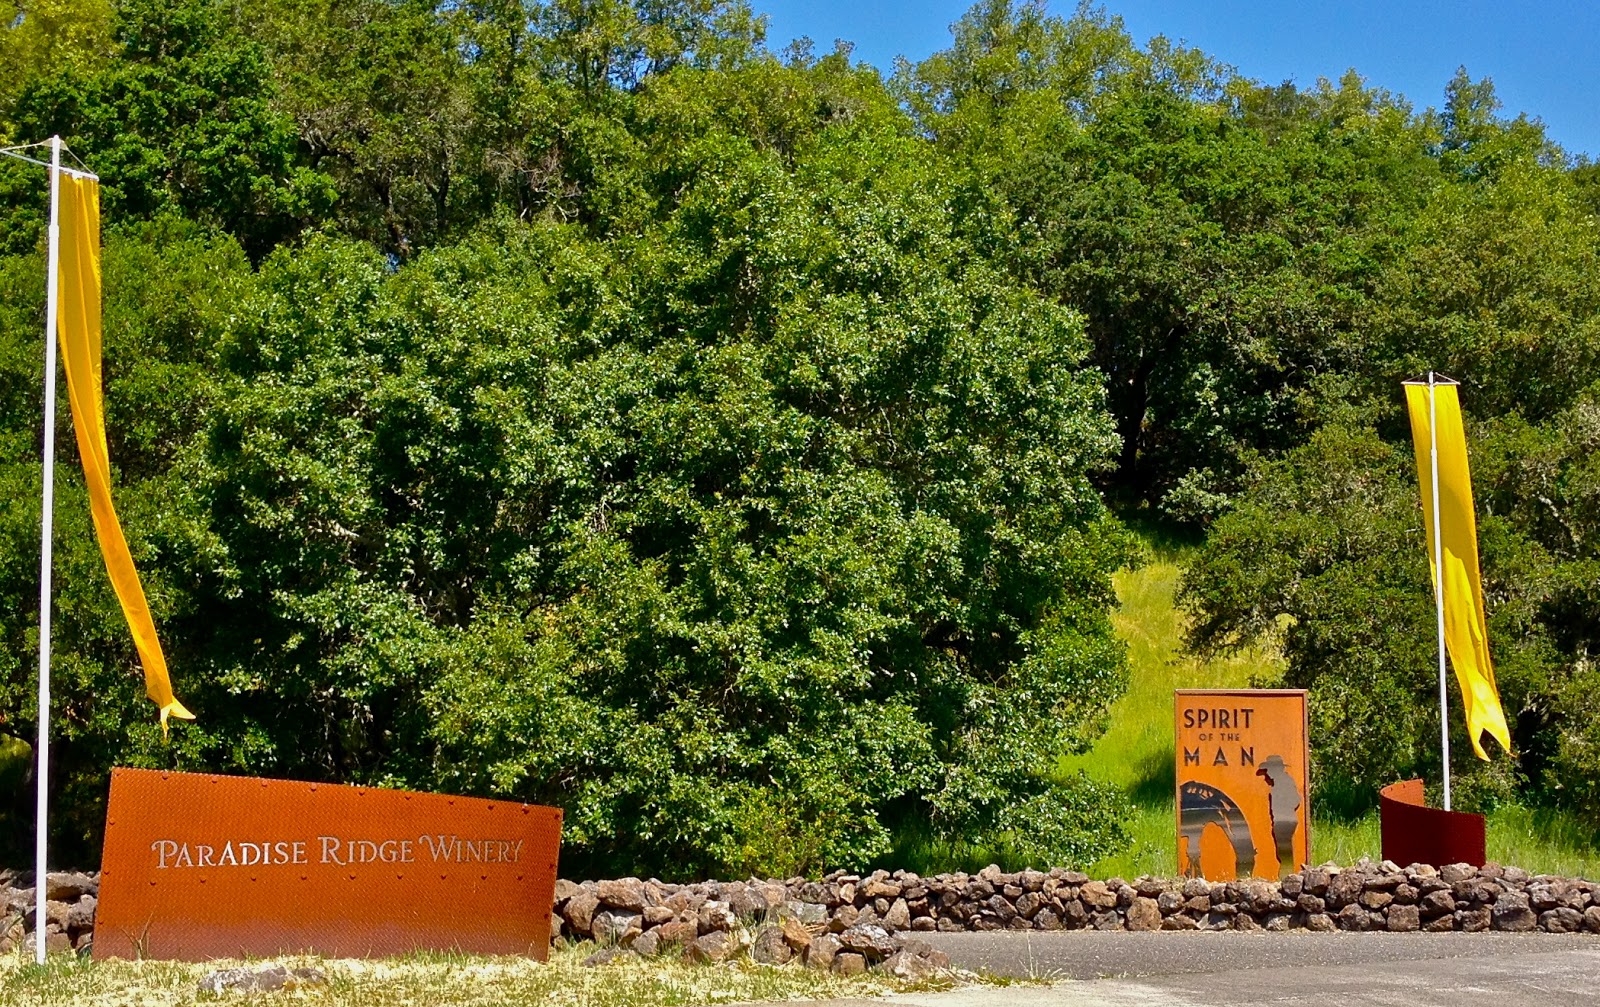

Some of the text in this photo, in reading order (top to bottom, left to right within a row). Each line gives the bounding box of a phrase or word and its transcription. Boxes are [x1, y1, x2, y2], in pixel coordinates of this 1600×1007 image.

[1184, 708, 1254, 729] SPIRIT
[1199, 733, 1240, 742] OF THE
[1183, 746, 1255, 767] MAN
[151, 834, 524, 869] PARADISE RIDGE WINERY
